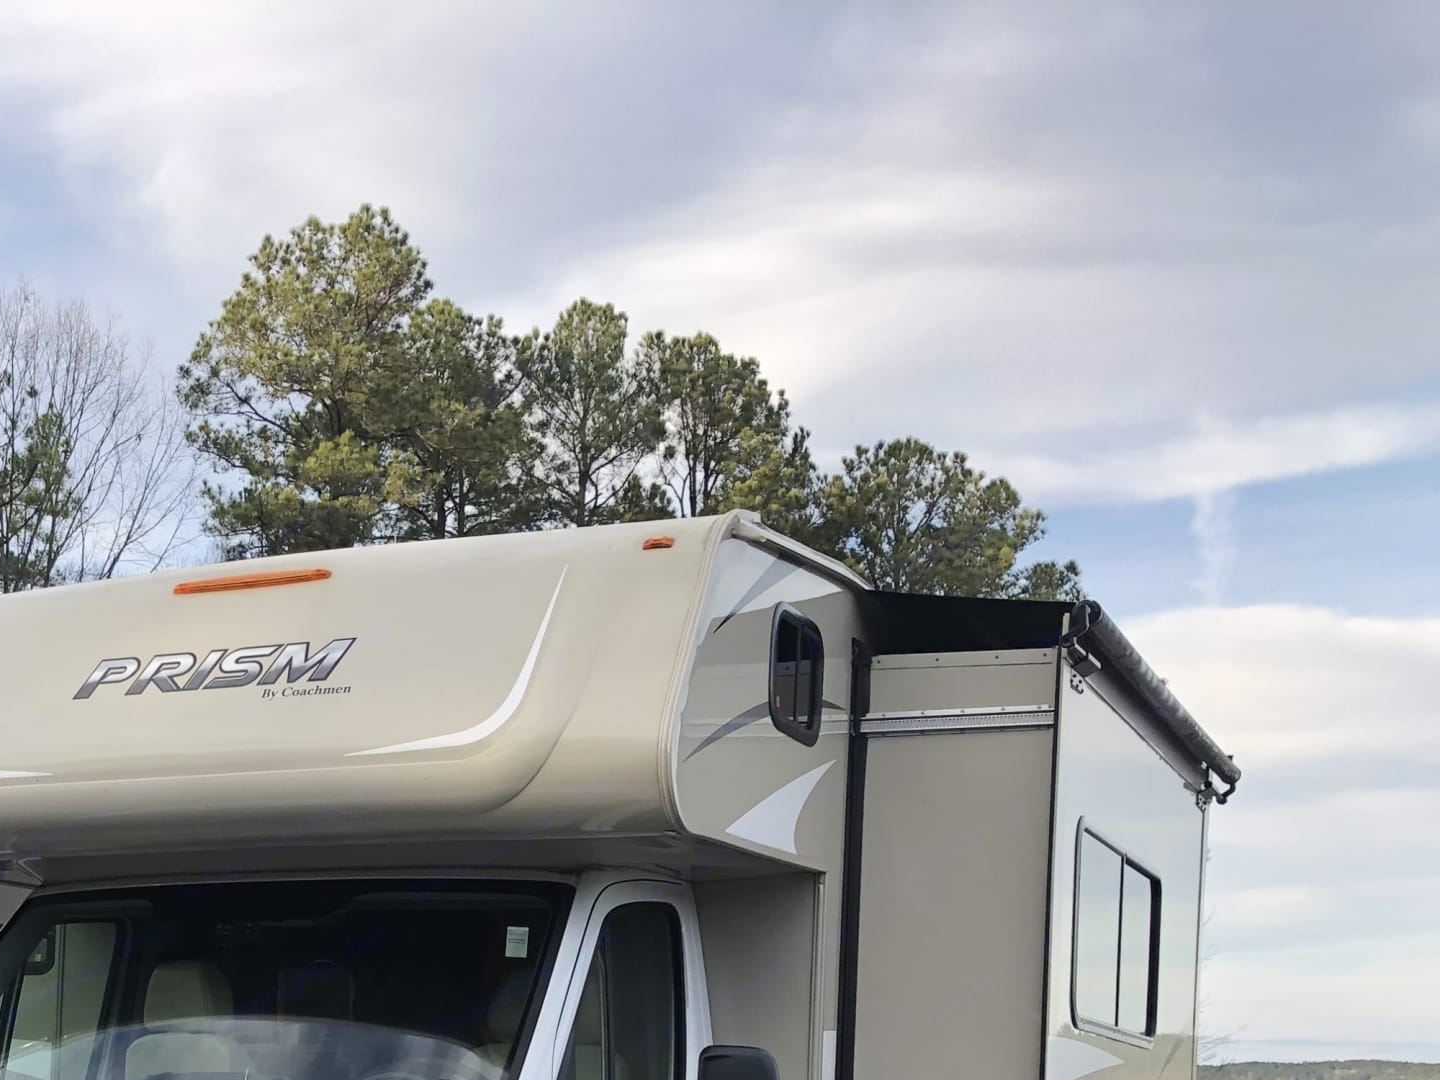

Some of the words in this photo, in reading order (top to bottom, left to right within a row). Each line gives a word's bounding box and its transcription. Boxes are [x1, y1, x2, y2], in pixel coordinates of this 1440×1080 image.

[72, 637, 358, 700] PRISM
[262, 688, 278, 700] By
[281, 685, 351, 697] Coachmen
